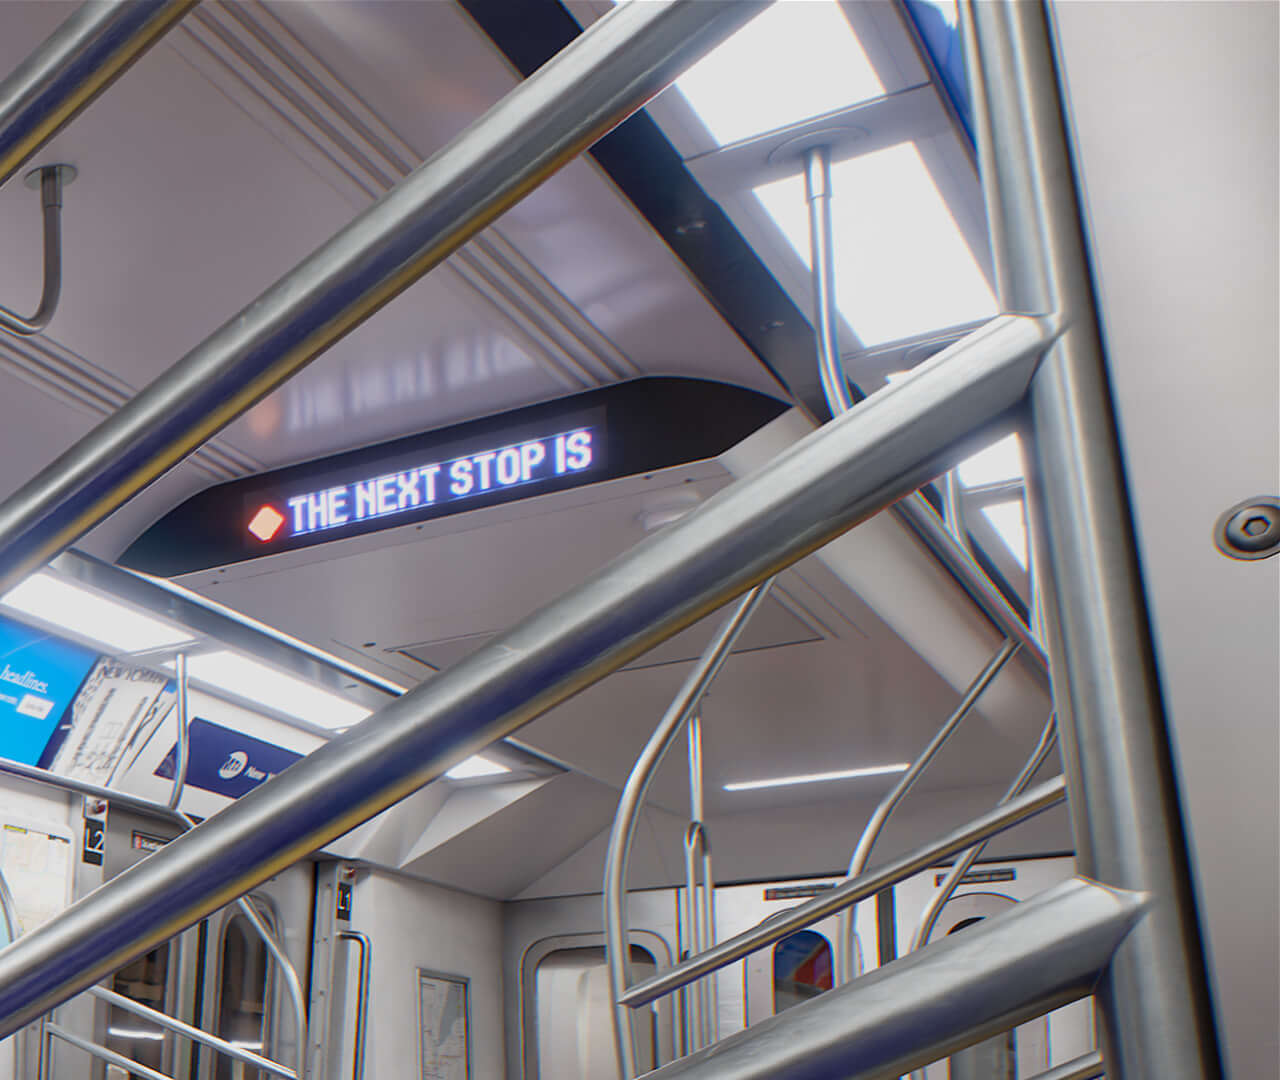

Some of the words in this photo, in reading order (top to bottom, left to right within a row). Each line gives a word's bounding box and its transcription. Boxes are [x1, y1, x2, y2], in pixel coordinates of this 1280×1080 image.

[289, 485, 349, 532] THE
[355, 465, 440, 519] NEXT
[449, 442, 546, 496] STOP
[554, 431, 593, 474] IS
[86, 827, 105, 855] L2
[338, 889, 351, 911] L1
